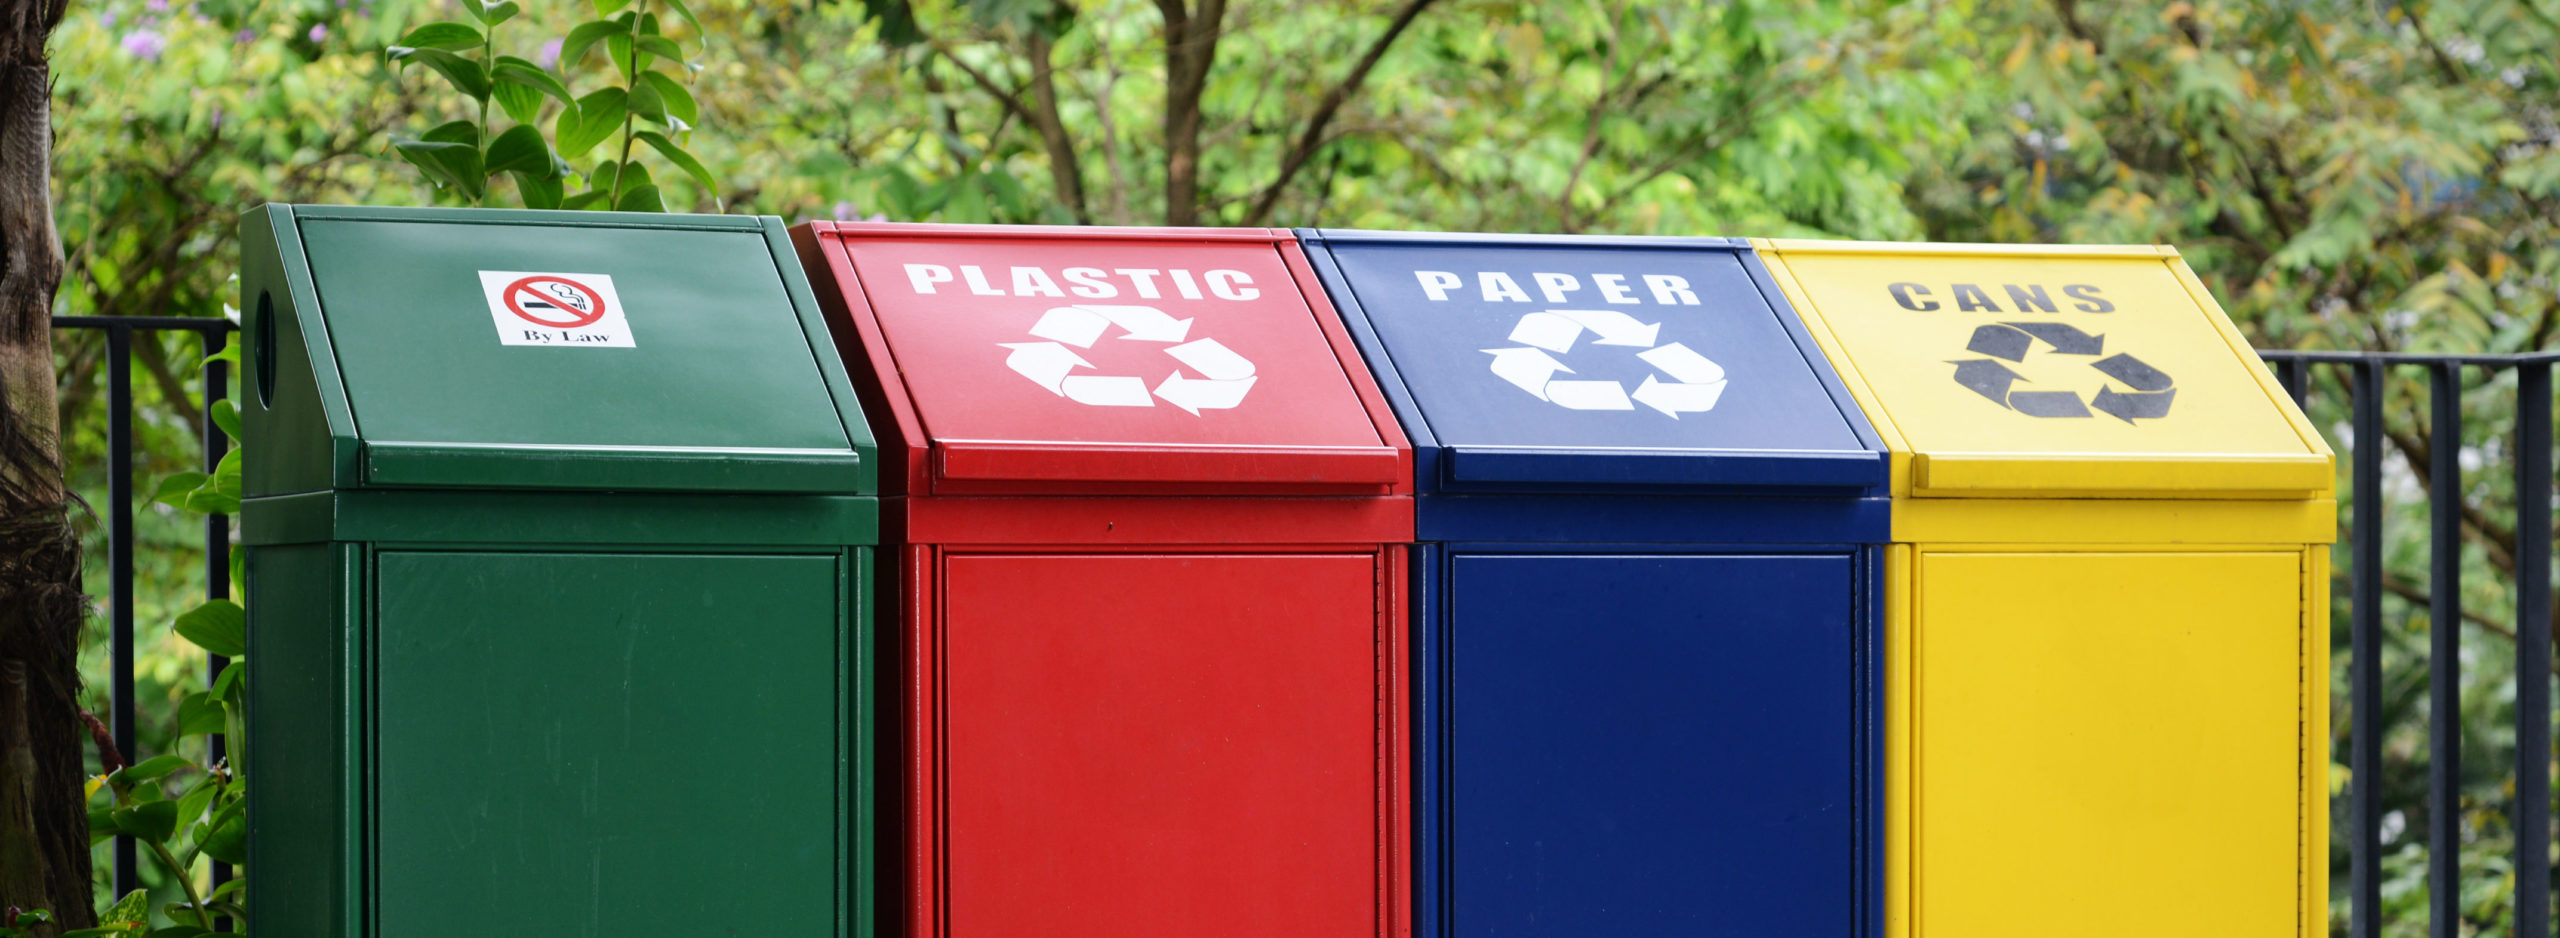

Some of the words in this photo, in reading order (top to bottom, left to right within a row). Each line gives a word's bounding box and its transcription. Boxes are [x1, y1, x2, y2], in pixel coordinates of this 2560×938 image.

[903, 263, 1261, 302] PLASTIC
[1415, 270, 1702, 307] PAPER
[1888, 281, 2117, 315] CANS
[521, 329, 552, 344] By
[561, 331, 611, 343] Law
